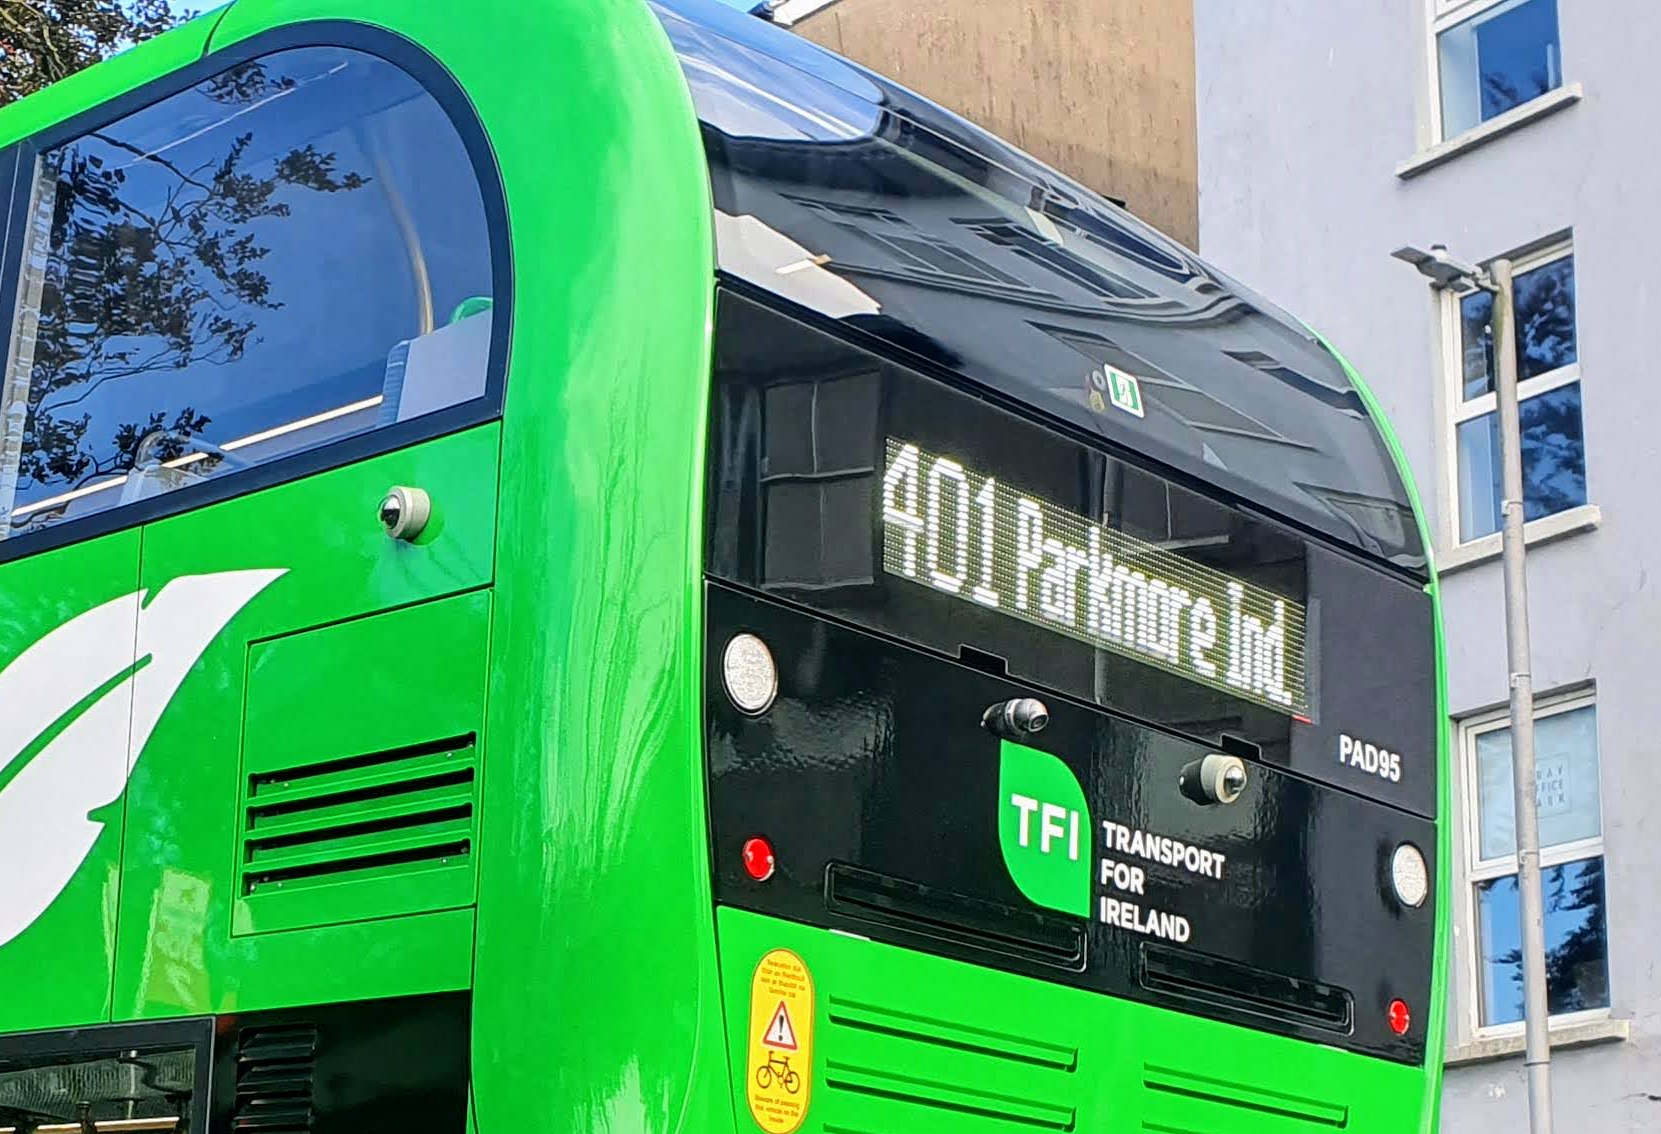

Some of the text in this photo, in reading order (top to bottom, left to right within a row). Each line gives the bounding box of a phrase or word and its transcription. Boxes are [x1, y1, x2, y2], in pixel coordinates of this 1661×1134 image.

[883, 444, 1292, 705] 401 Parkmore Ind
[1339, 734, 1402, 782] PAD95
[1011, 793, 1079, 861] TFI
[1102, 820, 1226, 879] TRANSPORT
[1100, 863, 1144, 895] FOR
[1100, 903, 1190, 943] IRELAND
